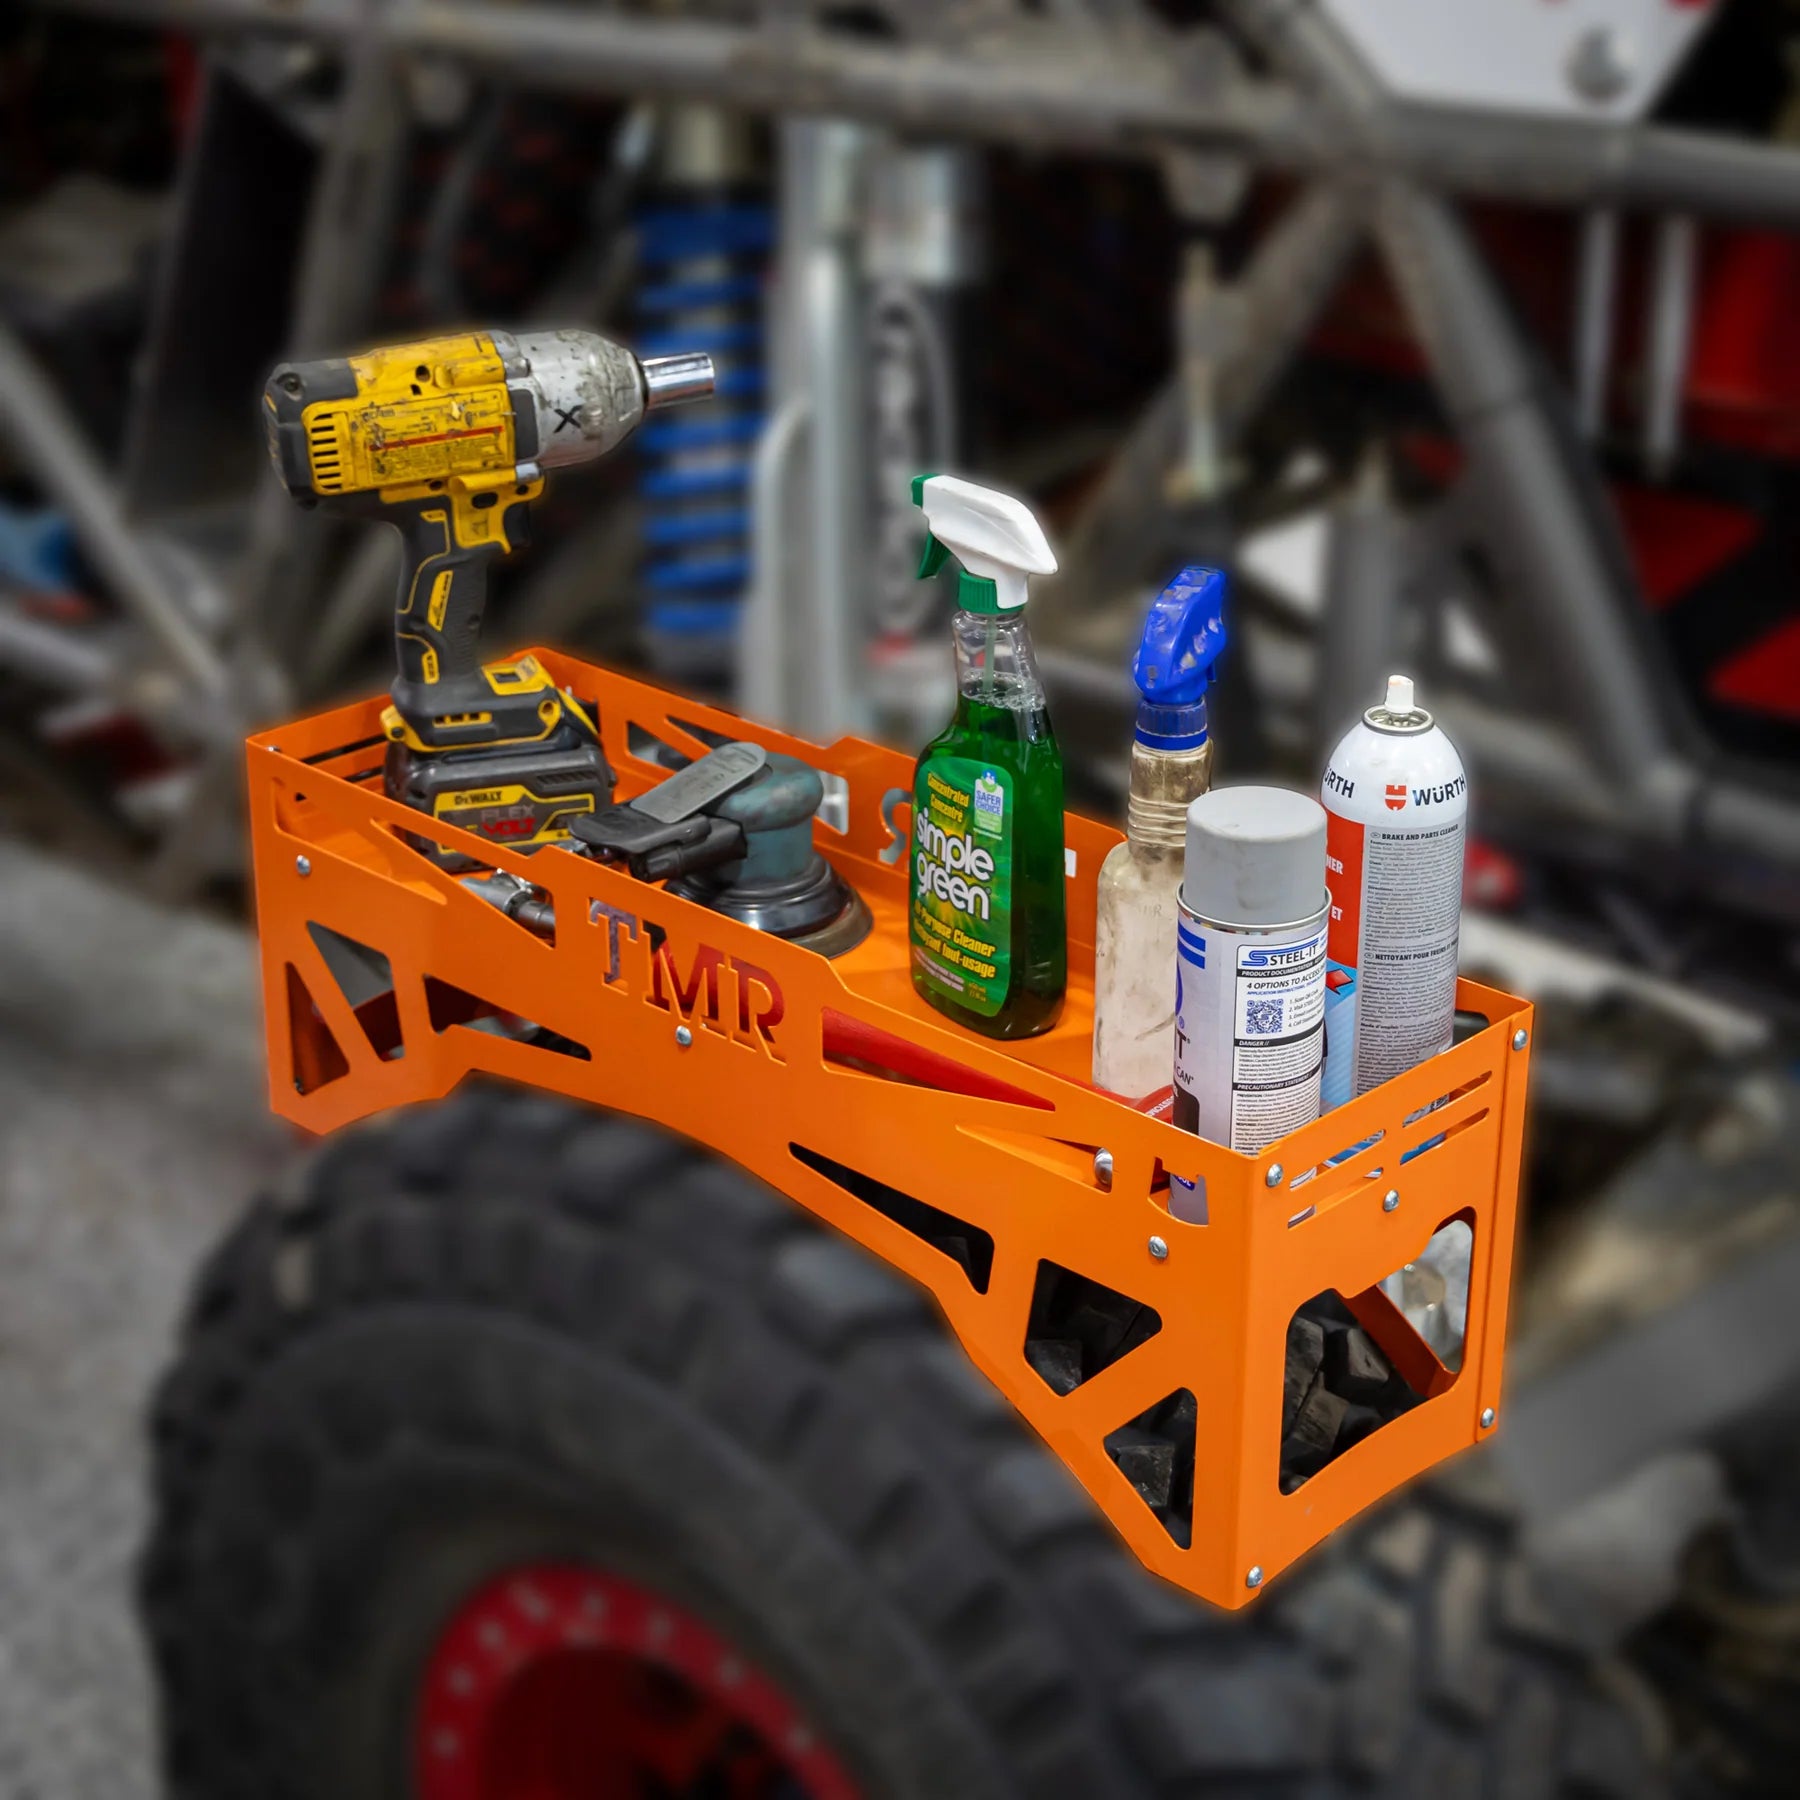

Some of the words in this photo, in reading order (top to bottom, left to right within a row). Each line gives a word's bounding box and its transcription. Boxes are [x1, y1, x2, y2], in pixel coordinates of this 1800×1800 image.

[976, 790, 1001, 807] SAFER
[976, 799, 1001, 816] CHOICE
[481, 816, 536, 836] VOLT
[1421, 830, 1439, 839] PARTS
[1440, 823, 1458, 836] CLEANER
[917, 807, 994, 881] simple
[917, 852, 989, 920] green
[953, 928, 996, 957] Cleaner
[1270, 943, 1318, 966] STEEL-IT
[1413, 949, 1429, 959] POUR
[588, 897, 787, 1066] TMR
[1254, 979, 1289, 989] OPTIONS
[1290, 976, 1301, 985] TO
[1237, 1081, 1285, 1090] PRECAUTIONARY
